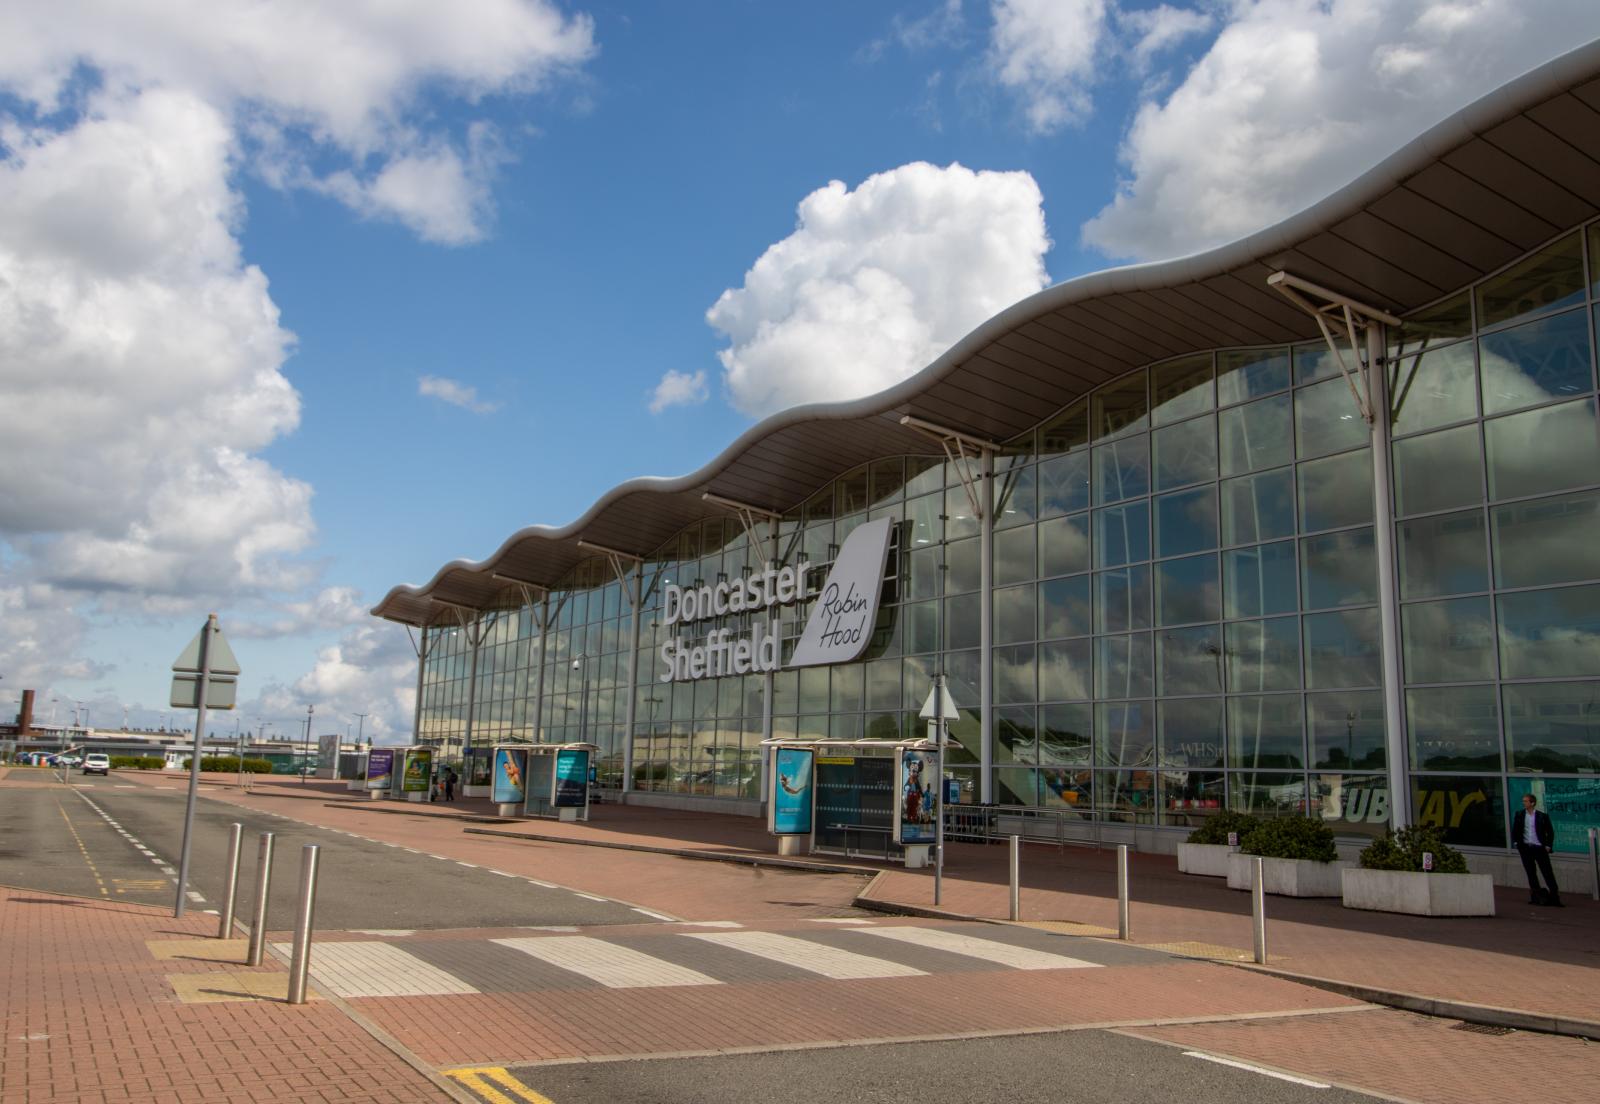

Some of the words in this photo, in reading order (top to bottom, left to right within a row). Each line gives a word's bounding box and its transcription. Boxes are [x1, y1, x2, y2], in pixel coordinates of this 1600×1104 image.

[664, 561, 811, 625] Doncaster
[821, 582, 868, 618] Robin
[660, 619, 782, 682] Sheffield
[819, 615, 866, 648] Hood
